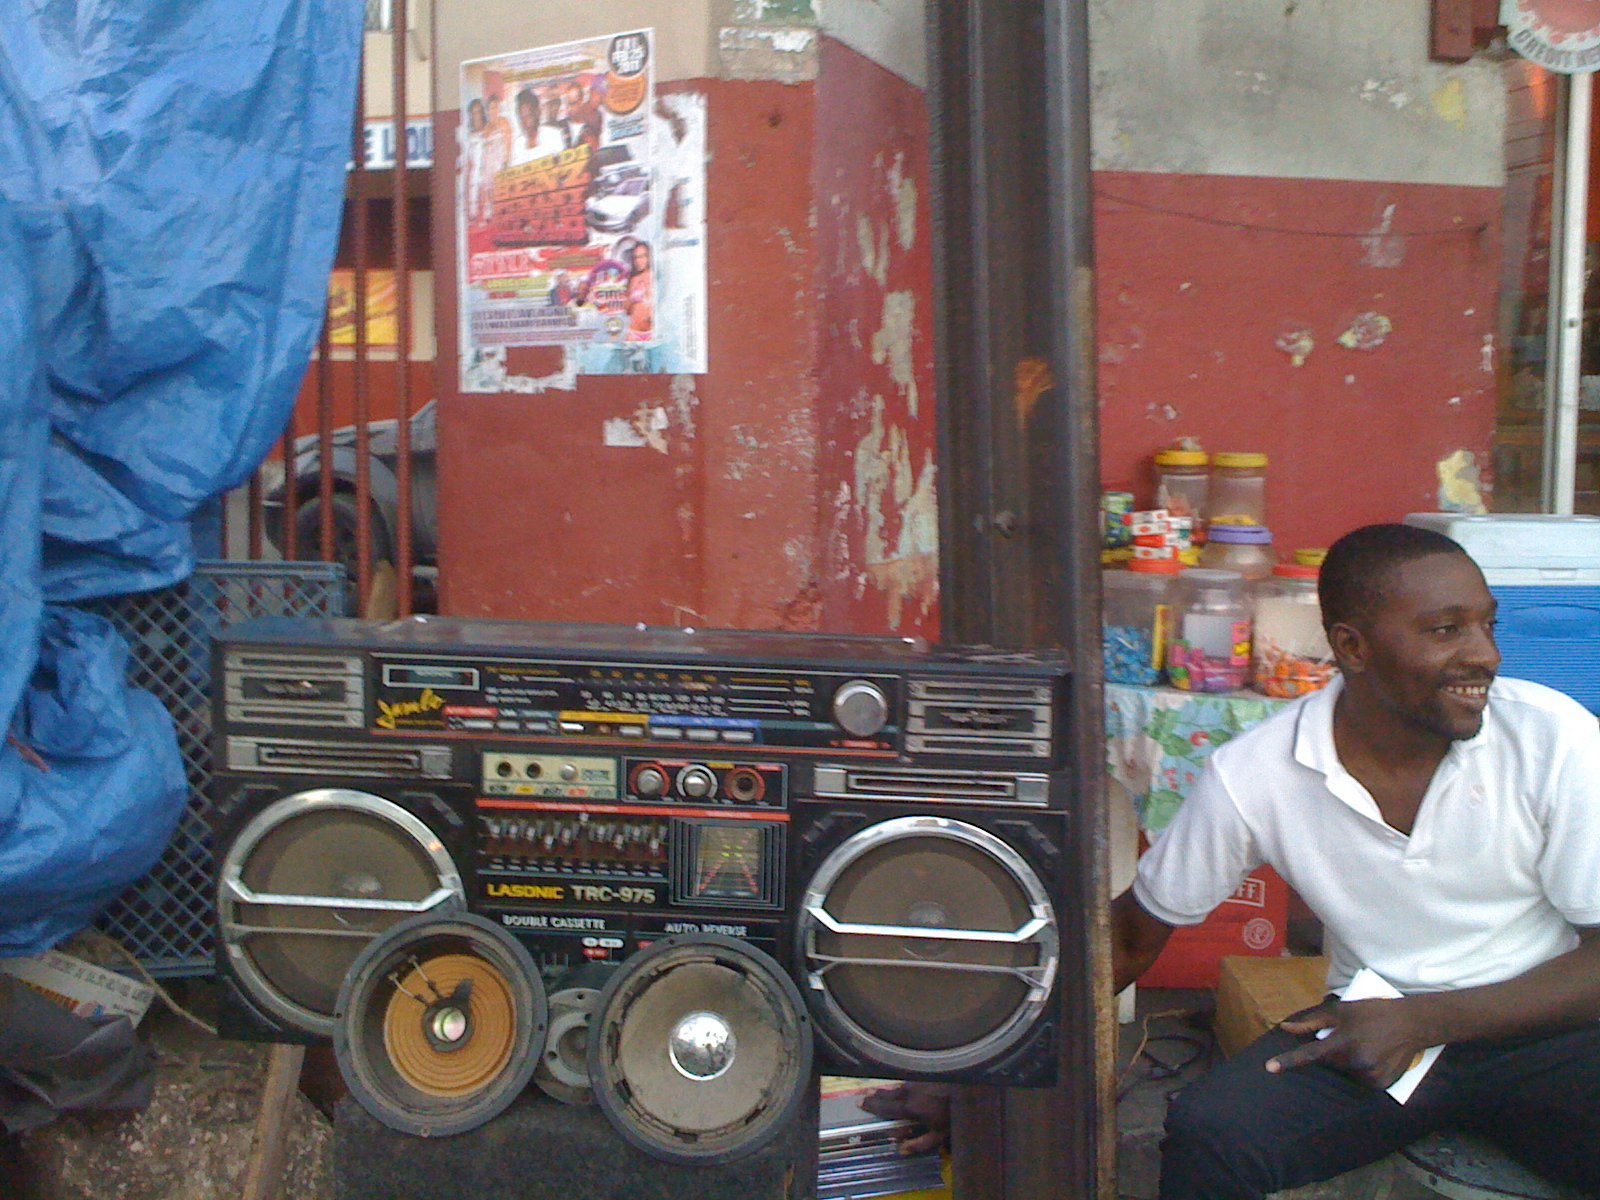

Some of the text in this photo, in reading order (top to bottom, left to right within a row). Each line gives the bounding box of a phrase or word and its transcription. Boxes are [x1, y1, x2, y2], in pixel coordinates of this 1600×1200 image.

[487, 884, 656, 903] LASONIC TRC-975
[502, 914, 606, 929] DOUBLE CASSETTE
[664, 923, 699, 934] AUTO
